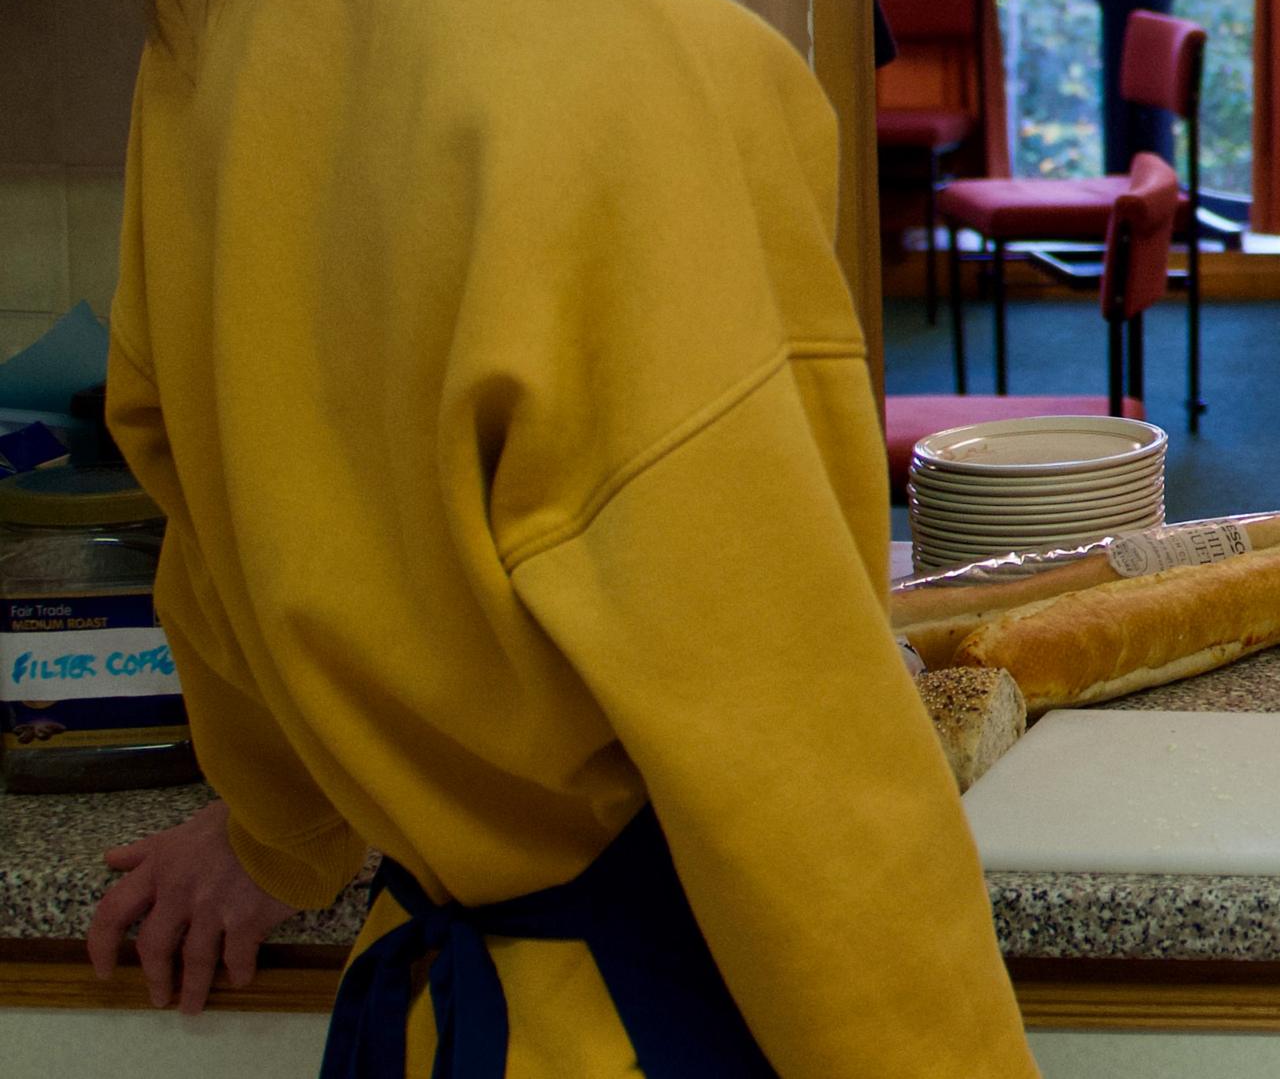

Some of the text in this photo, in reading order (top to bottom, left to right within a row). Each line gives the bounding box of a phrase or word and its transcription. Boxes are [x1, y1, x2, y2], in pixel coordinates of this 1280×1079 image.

[11, 604, 73, 617] Fair Trade
[12, 617, 109, 630] MEDIUM ROAST
[11, 651, 97, 684] FILTER
